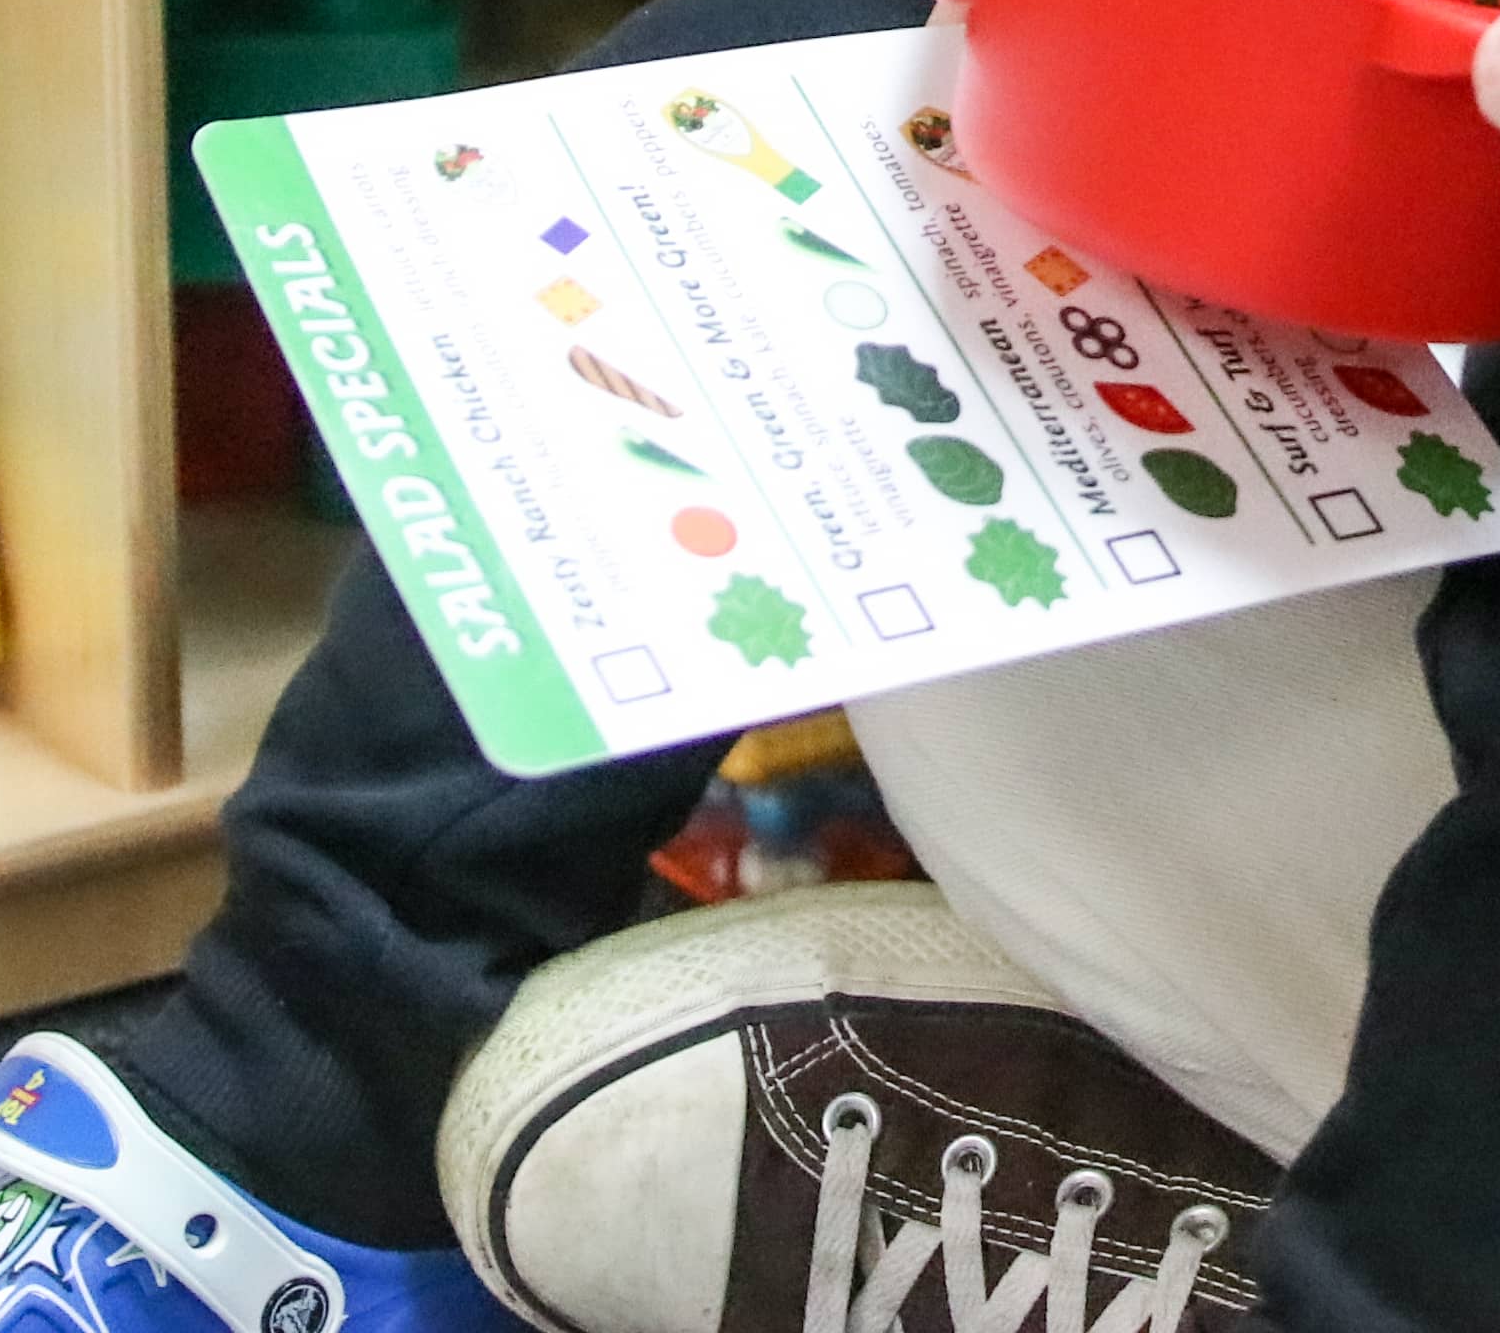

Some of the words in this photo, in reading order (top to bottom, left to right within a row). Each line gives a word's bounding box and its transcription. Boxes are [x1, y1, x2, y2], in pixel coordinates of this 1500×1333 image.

[383, 162, 441, 247] dressing
[616, 182, 689, 271] Green!
[918, 214, 984, 303] spinach,
[940, 200, 1021, 311] vinaigrette
[252, 220, 419, 463] SPECIALS
[677, 277, 734, 347] More
[1191, 324, 1255, 384] Turf
[430, 331, 503, 444] Chicken
[721, 355, 754, 382] &
[1014, 310, 1088, 413] croutons,
[1241, 385, 1278, 417] &
[1291, 353, 1361, 439] dressing
[744, 388, 805, 472] Green
[975, 314, 1119, 518] Mediterranean
[1081, 413, 1133, 485] olives,
[1255, 420, 1321, 478] Surf
[490, 459, 554, 545] Ranch
[836, 415, 918, 531] vinaigrette
[377, 472, 523, 661] SALAD
[801, 486, 865, 573] Green,
[553, 555, 607, 629] Zesty
[24, 1068, 47, 1091] 4
